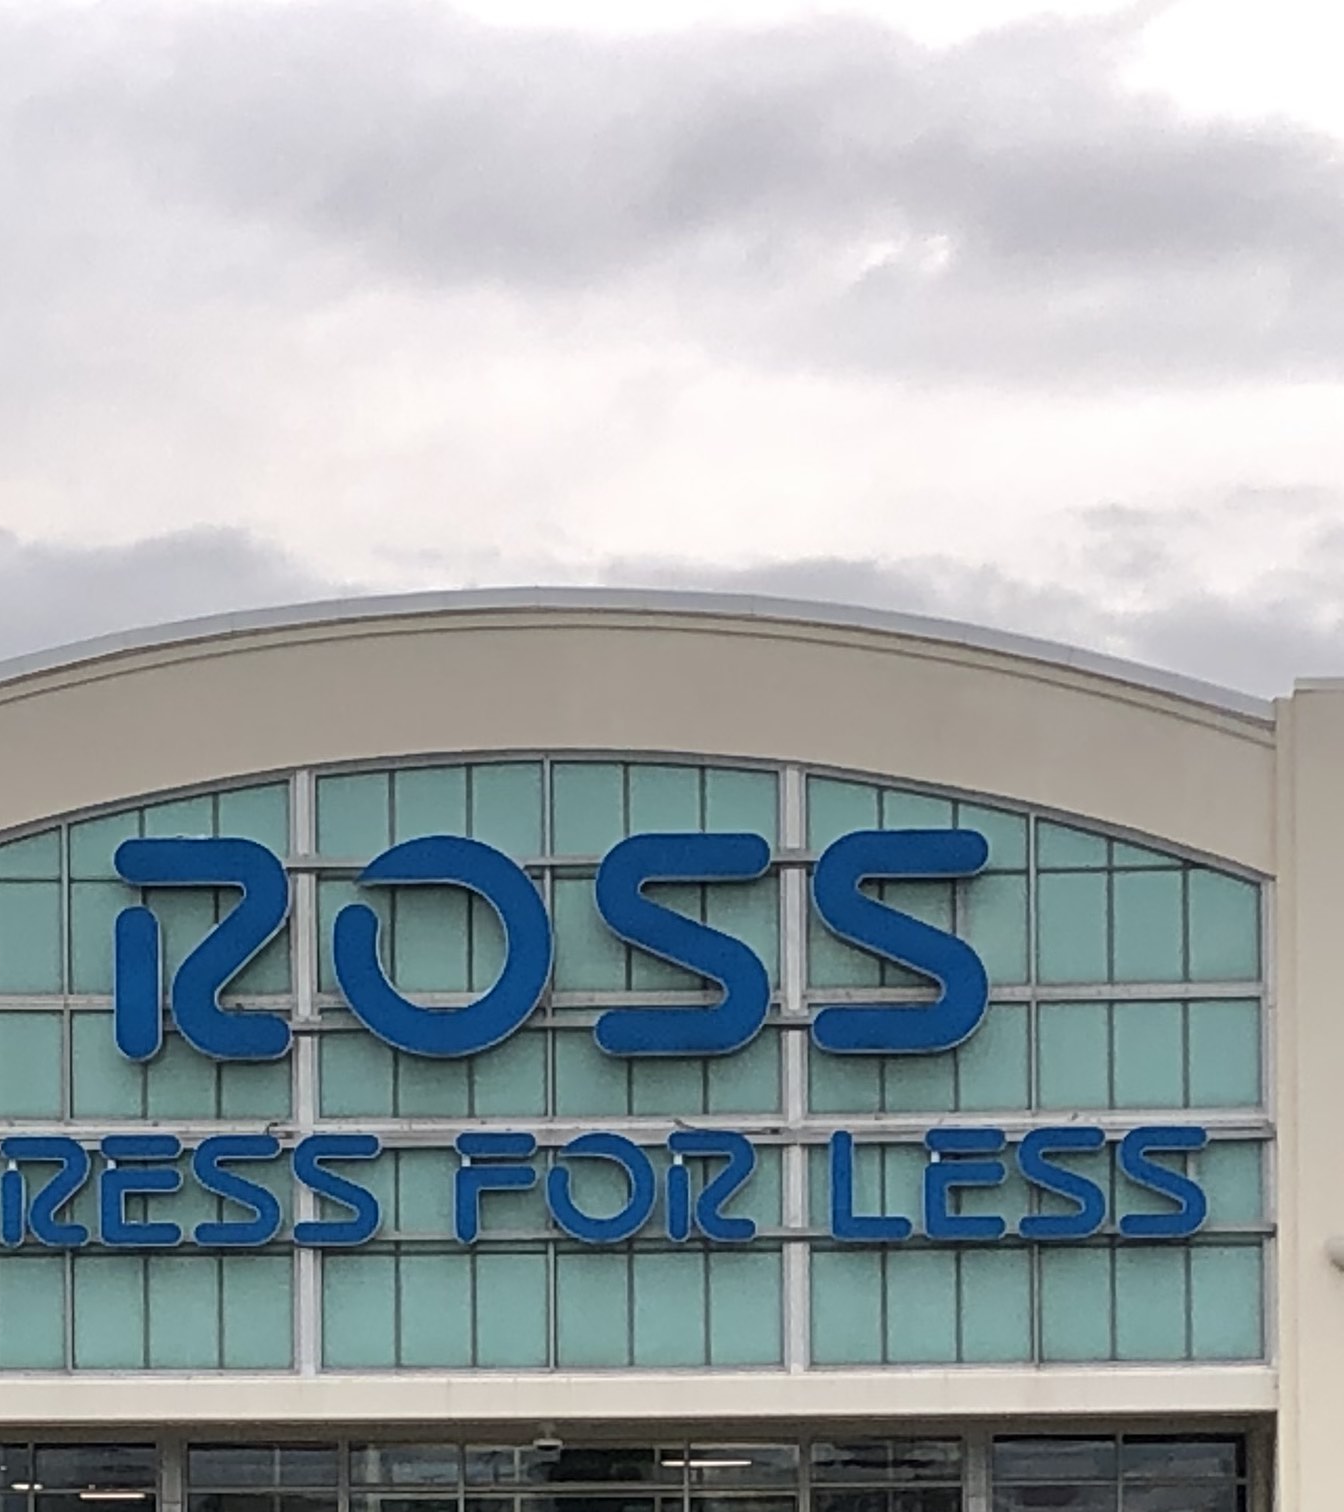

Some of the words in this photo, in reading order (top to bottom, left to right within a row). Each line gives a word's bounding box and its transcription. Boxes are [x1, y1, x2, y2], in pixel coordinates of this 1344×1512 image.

[114, 830, 989, 1061] ROSS
[455, 1130, 757, 1244] FOR
[829, 1127, 1209, 1241] LESS
